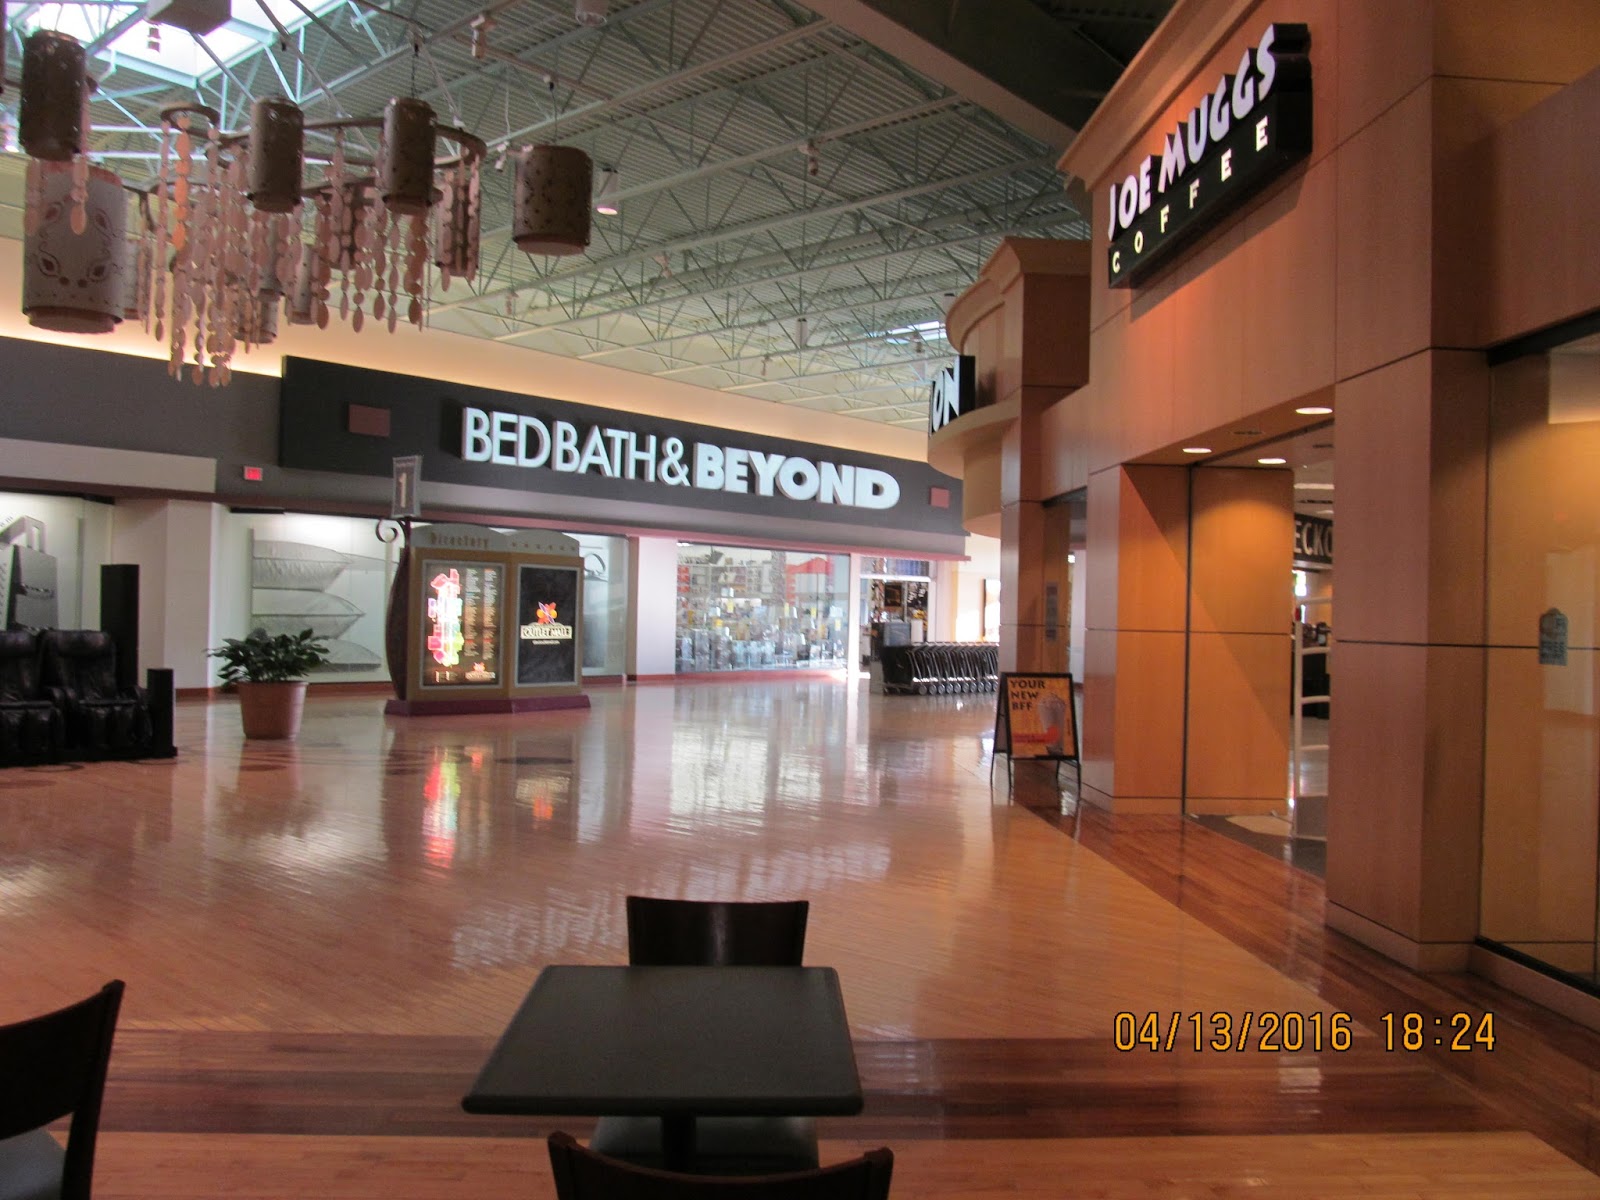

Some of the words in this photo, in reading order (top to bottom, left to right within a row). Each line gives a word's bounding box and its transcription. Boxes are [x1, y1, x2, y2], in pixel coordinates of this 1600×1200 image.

[1107, 154, 1151, 242] JOE
[1157, 23, 1276, 194] MUGGS
[1112, 115, 1269, 274] COFFEE
[462, 406, 552, 468] BED
[551, 419, 657, 483] BATH
[657, 437, 691, 487] &
[693, 441, 900, 510] BEYOND
[399, 472, 408, 508] 1
[1010, 680, 1046, 689] YOUR
[1011, 691, 1039, 700] NEW
[1012, 702, 1033, 711] BFF
